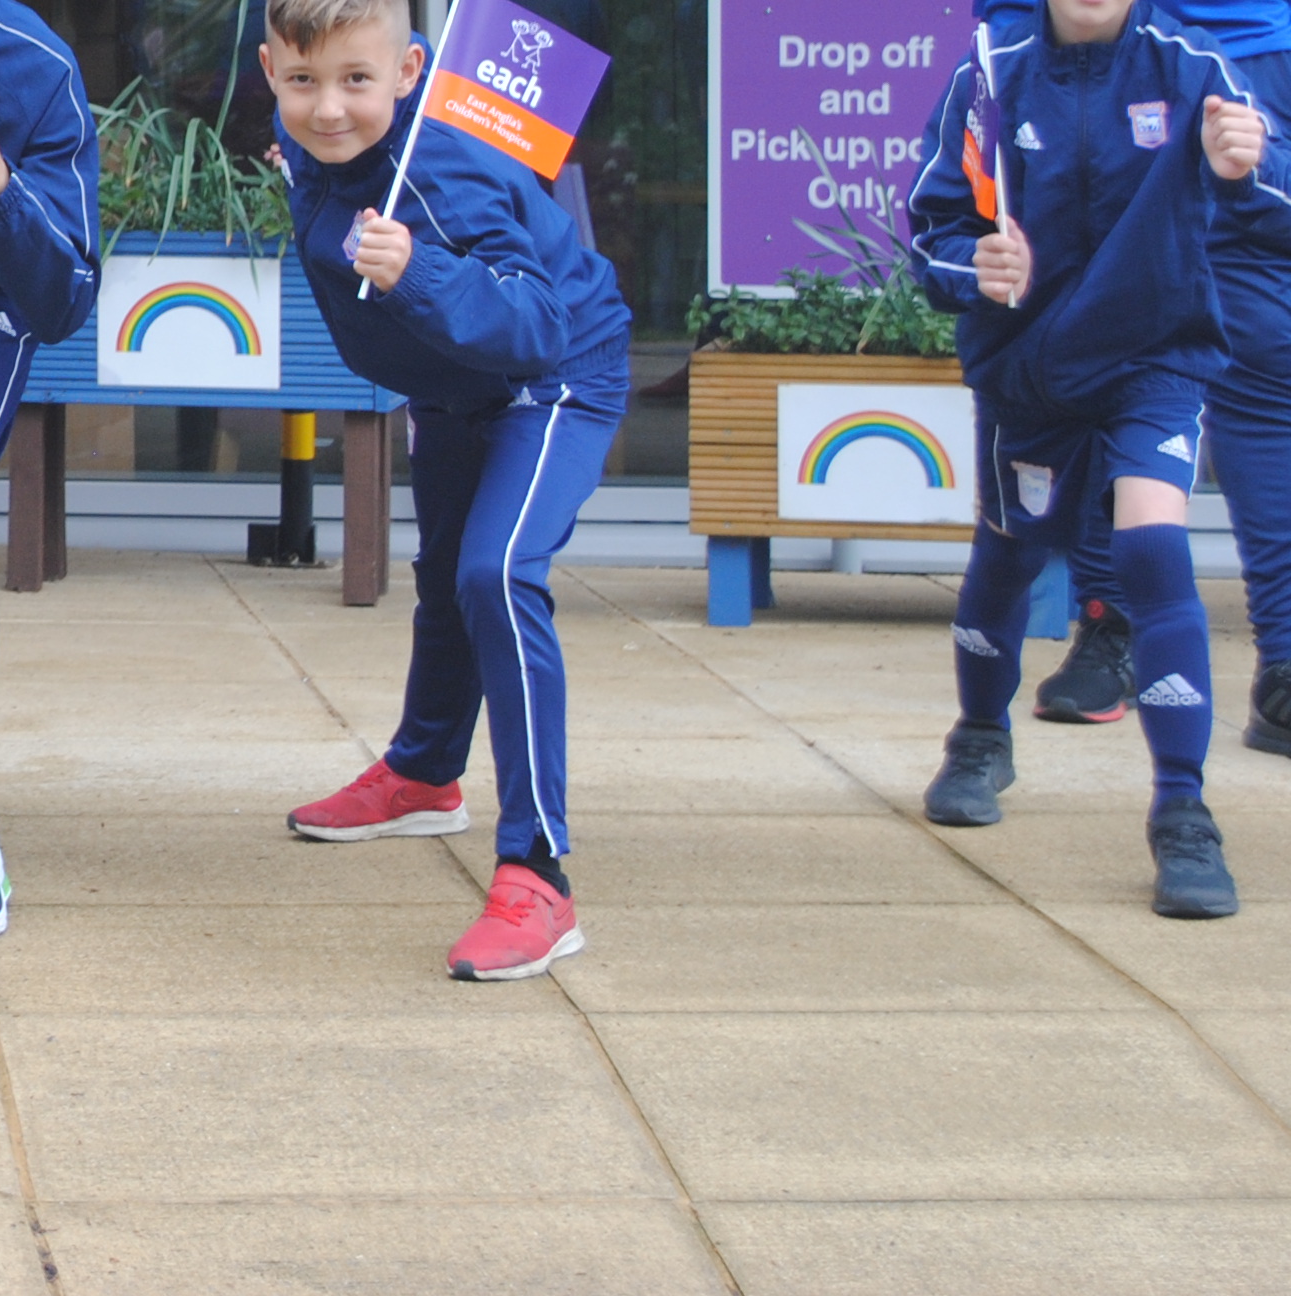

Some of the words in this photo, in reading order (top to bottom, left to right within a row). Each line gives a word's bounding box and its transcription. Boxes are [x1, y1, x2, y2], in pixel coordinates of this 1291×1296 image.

[778, 35, 870, 76] Drop
[882, 35, 935, 68] off
[476, 58, 543, 109] each
[819, 82, 891, 115] and
[445, 99, 490, 129] Children's
[493, 122, 533, 152] Hospices
[466, 93, 487, 113] East
[488, 107, 524, 132] Anglia's
[731, 128, 812, 162] Pick
[823, 136, 869, 170] up
[884, 136, 924, 170] po
[808, 176, 904, 217] Only.
[1137, 692, 1204, 706] adidas
